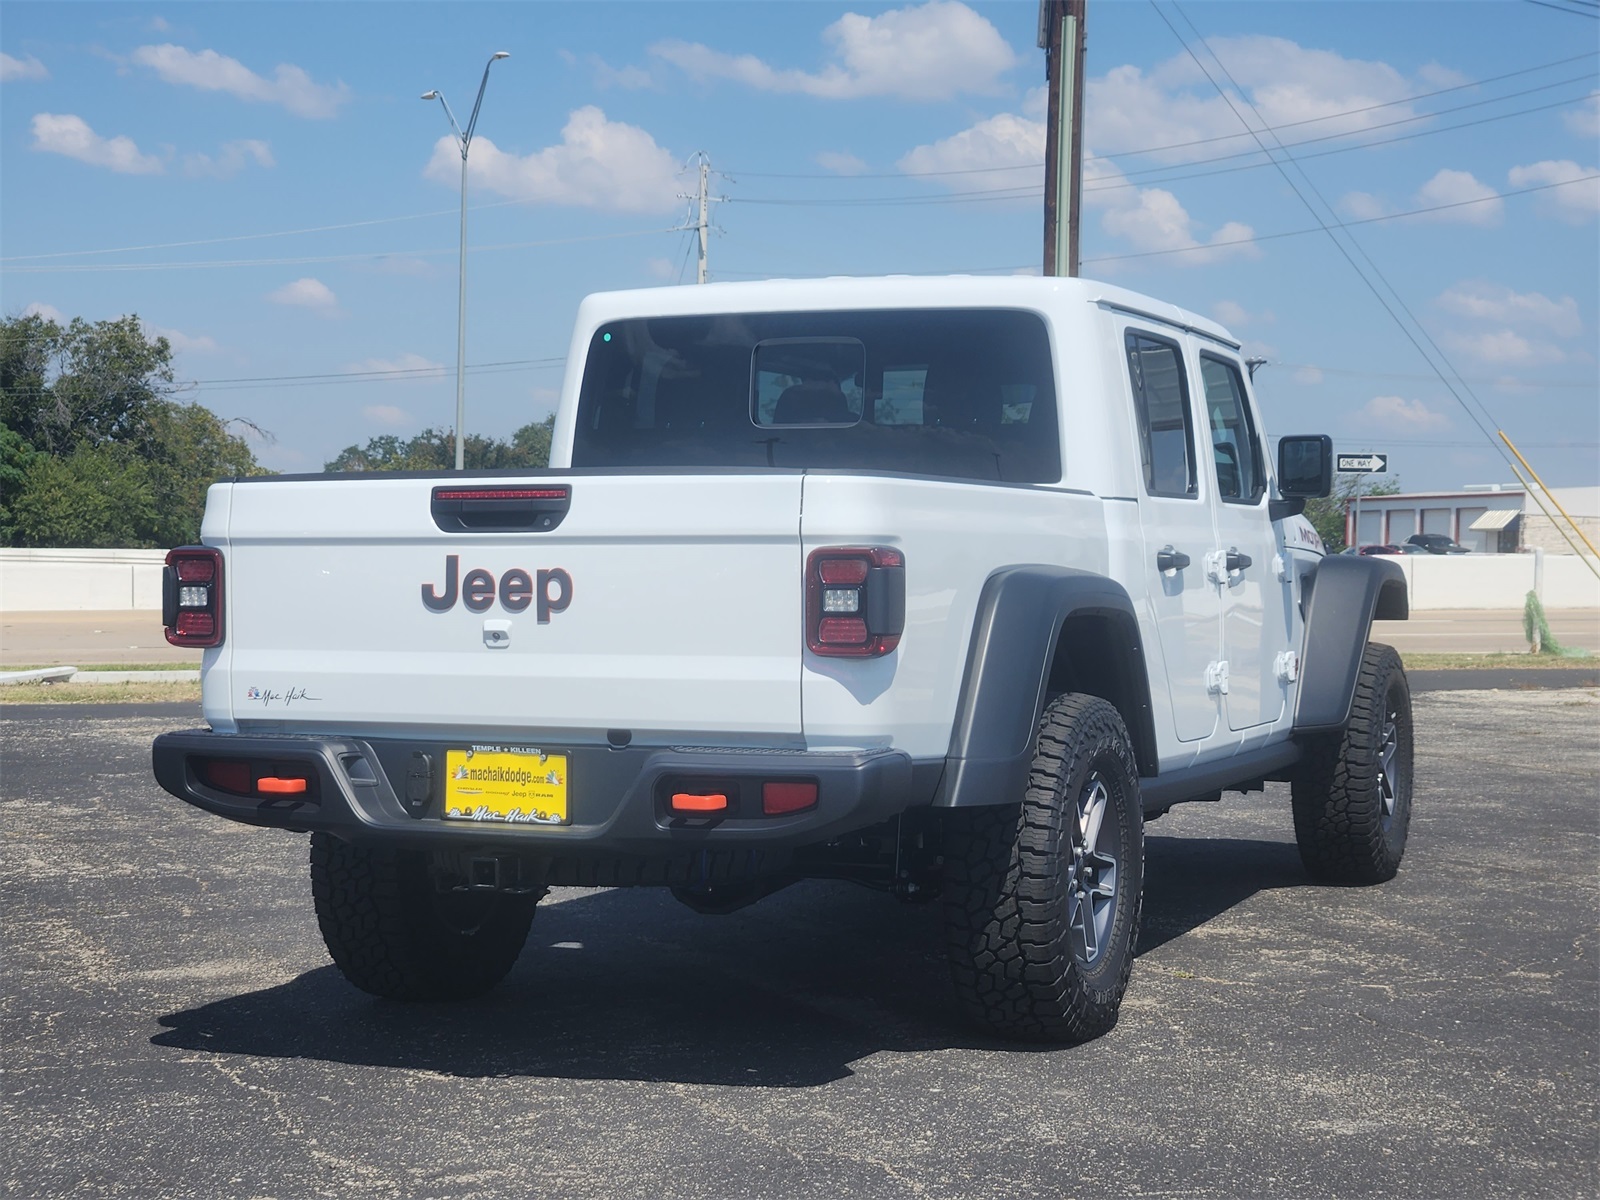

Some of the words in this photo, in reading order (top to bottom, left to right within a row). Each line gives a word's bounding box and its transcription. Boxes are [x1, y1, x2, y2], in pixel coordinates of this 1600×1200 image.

[1341, 459, 1355, 468] ONE
[1357, 459, 1372, 467] WAY
[421, 554, 573, 625] Jeep
[261, 689, 282, 707] Mac
[469, 766, 545, 786] machaikdodge.com
[511, 790, 527, 798] Jeep
[471, 805, 502, 821] Mac
[504, 807, 542, 823] Haik
